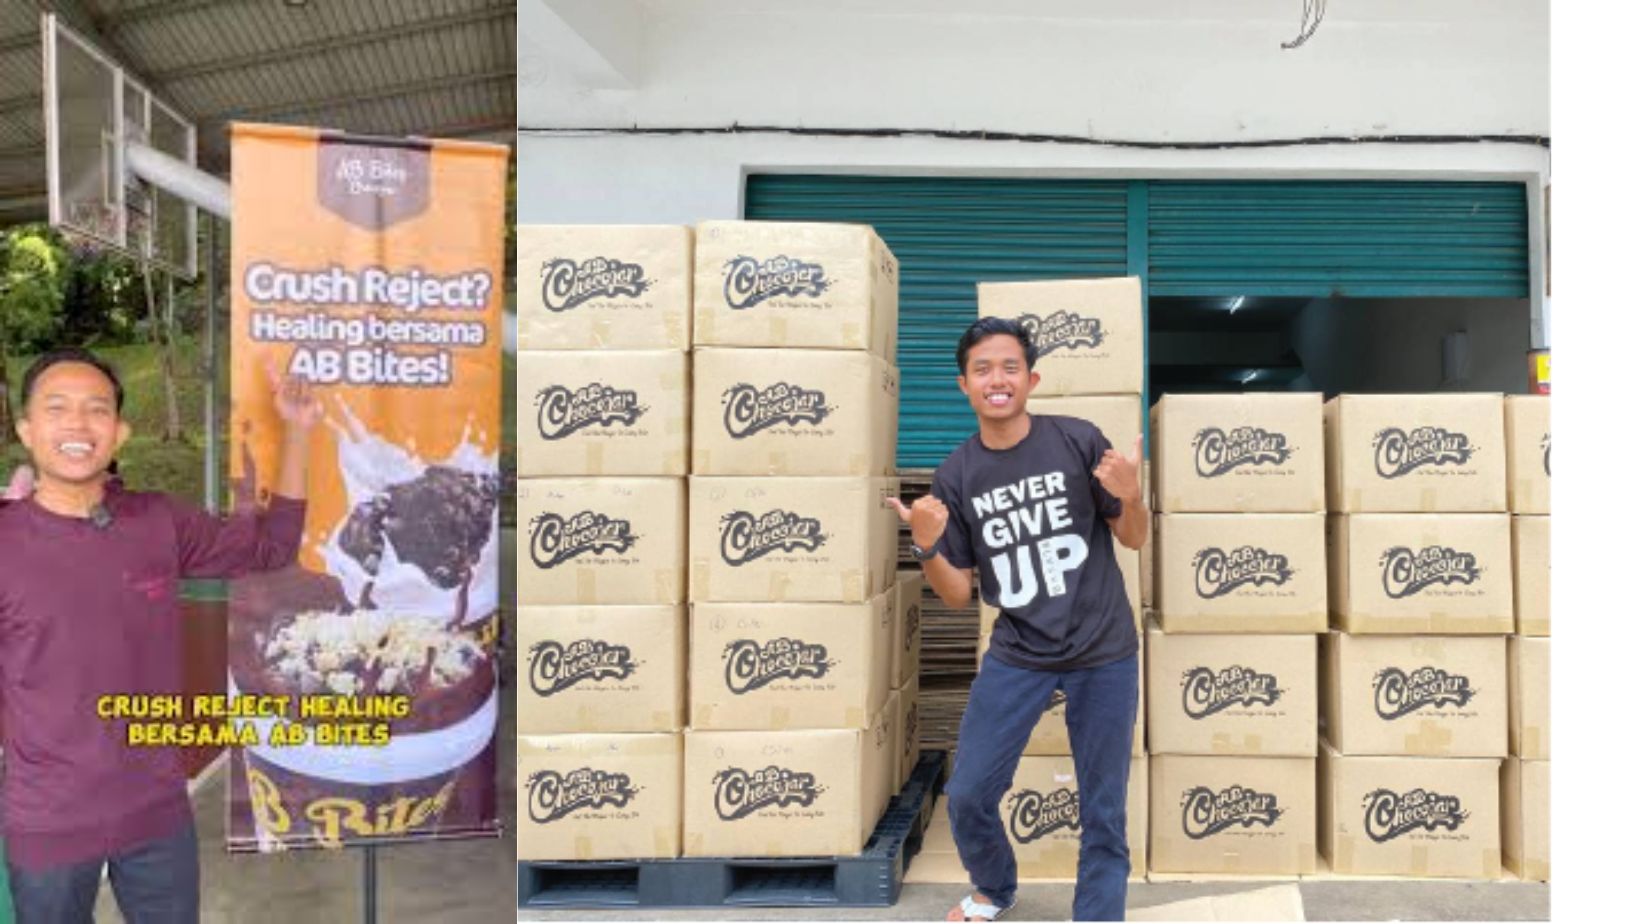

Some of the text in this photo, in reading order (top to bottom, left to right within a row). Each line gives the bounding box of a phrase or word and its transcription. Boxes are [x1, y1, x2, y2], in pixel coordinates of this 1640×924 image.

[245, 263, 491, 312] Crush Reject?
[252, 311, 485, 345] Healing bersama
[288, 348, 450, 384] AB Bites!
[1195, 428, 1287, 477] Chocojar
[1375, 428, 1468, 479] Chocojar
[971, 470, 1066, 519] NEVER
[982, 497, 1073, 548] GIVE
[990, 533, 1089, 608] UP
[1195, 548, 1288, 599] Chocojar
[1384, 548, 1476, 599] Chocojar
[1183, 667, 1277, 720] Chocojar
[1375, 667, 1469, 720] Chocojar
[1182, 787, 1277, 840] Chocojar
[1365, 789, 1460, 843] Chocojar
